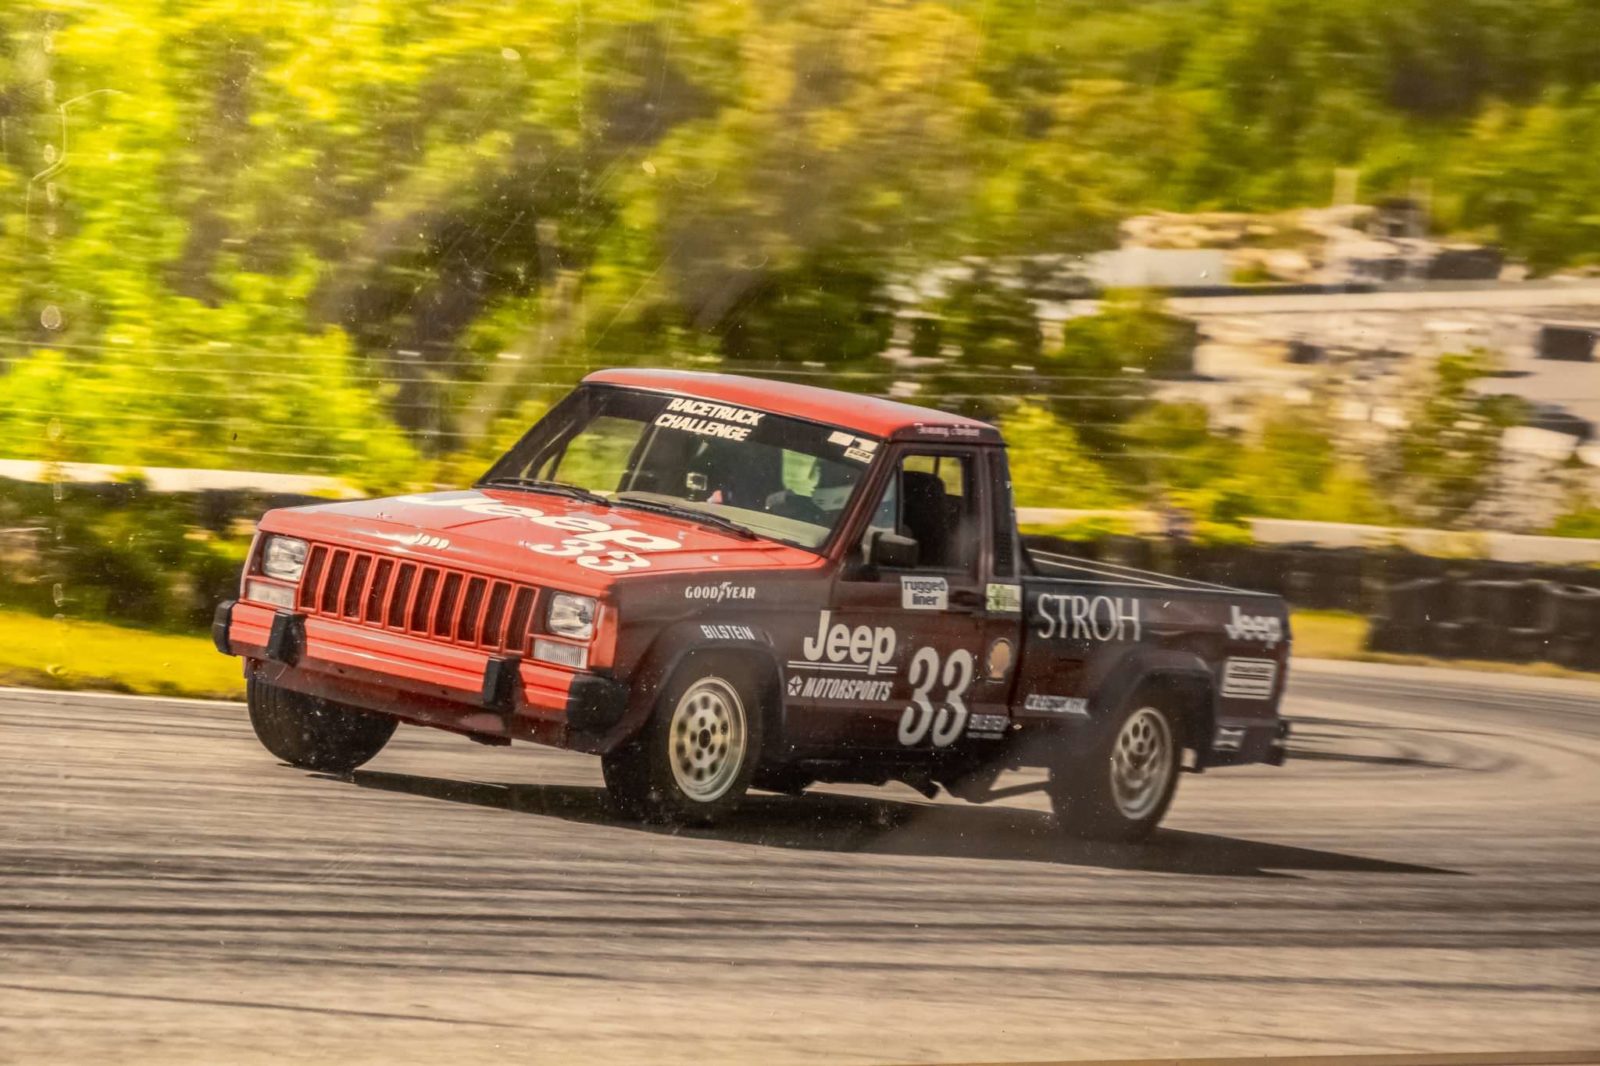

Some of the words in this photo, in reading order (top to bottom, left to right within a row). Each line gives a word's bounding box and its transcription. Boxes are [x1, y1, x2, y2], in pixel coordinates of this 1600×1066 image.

[655, 413, 751, 441] CHALLENGE
[666, 398, 764, 426] RACETRUCK
[397, 495, 682, 551] Jeep
[530, 538, 651, 572] 33
[684, 581, 756, 602] GOODYEAR
[700, 624, 755, 641] BILSTEIN
[1036, 593, 1141, 641] STROH
[803, 610, 896, 675] Jeep
[801, 677, 893, 702] MOTORSPORTS
[898, 646, 973, 747] 33
